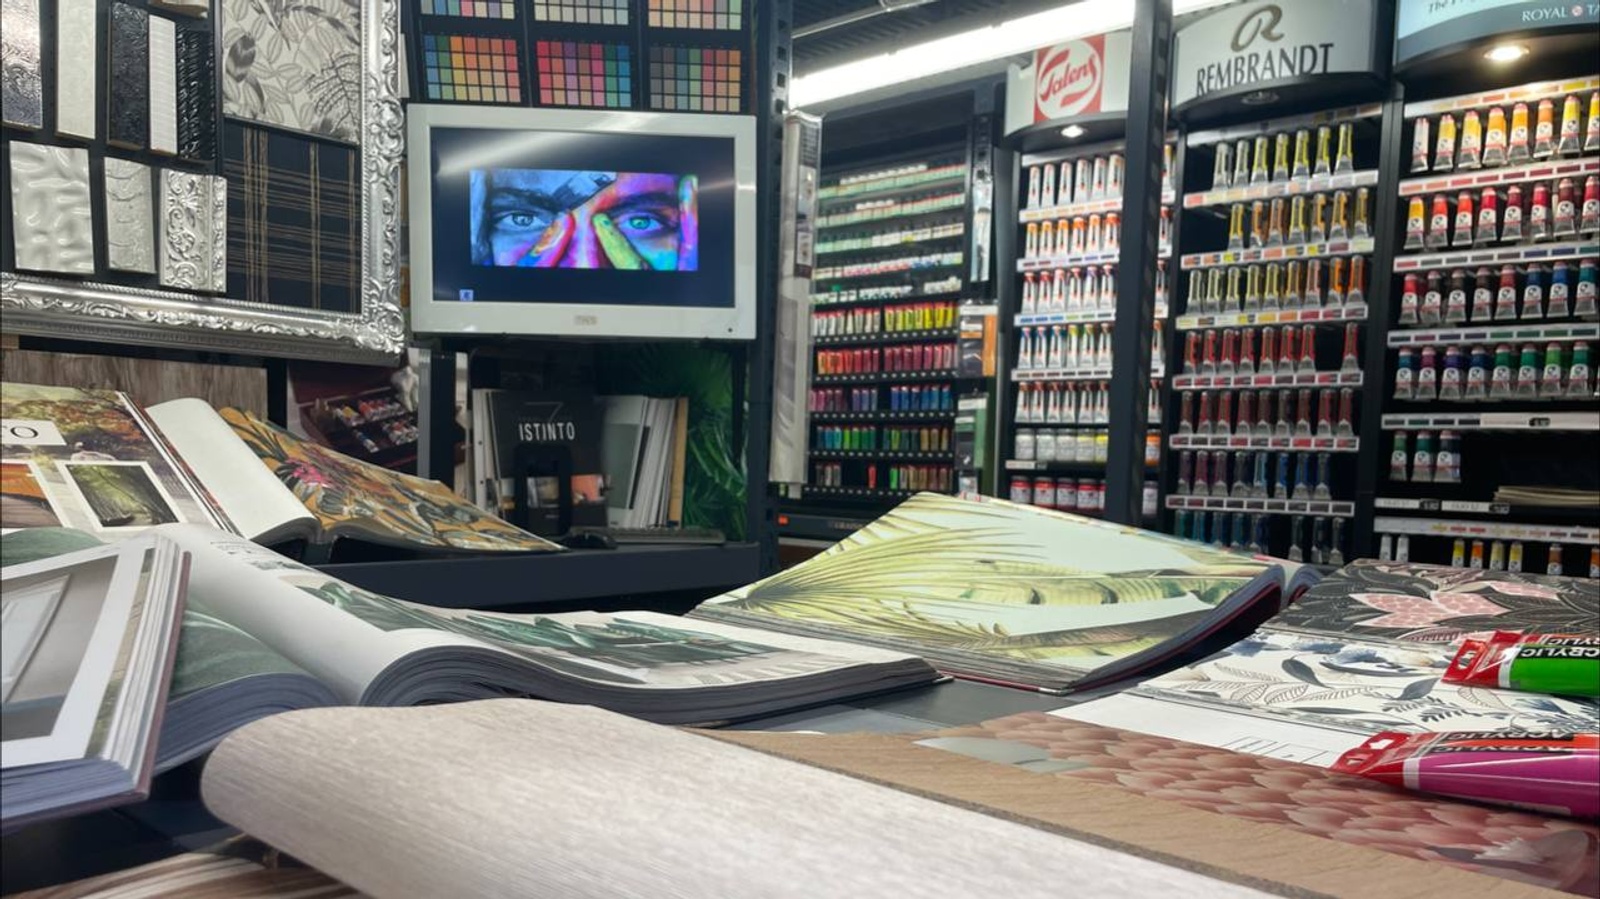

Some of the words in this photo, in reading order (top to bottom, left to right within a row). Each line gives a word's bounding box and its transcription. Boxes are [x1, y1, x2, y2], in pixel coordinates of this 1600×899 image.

[1522, 6, 1567, 22] ROYAL
[1040, 48, 1098, 107] Talens
[1196, 43, 1334, 97] REMBRANDT
[518, 421, 575, 441] ISTINTO
